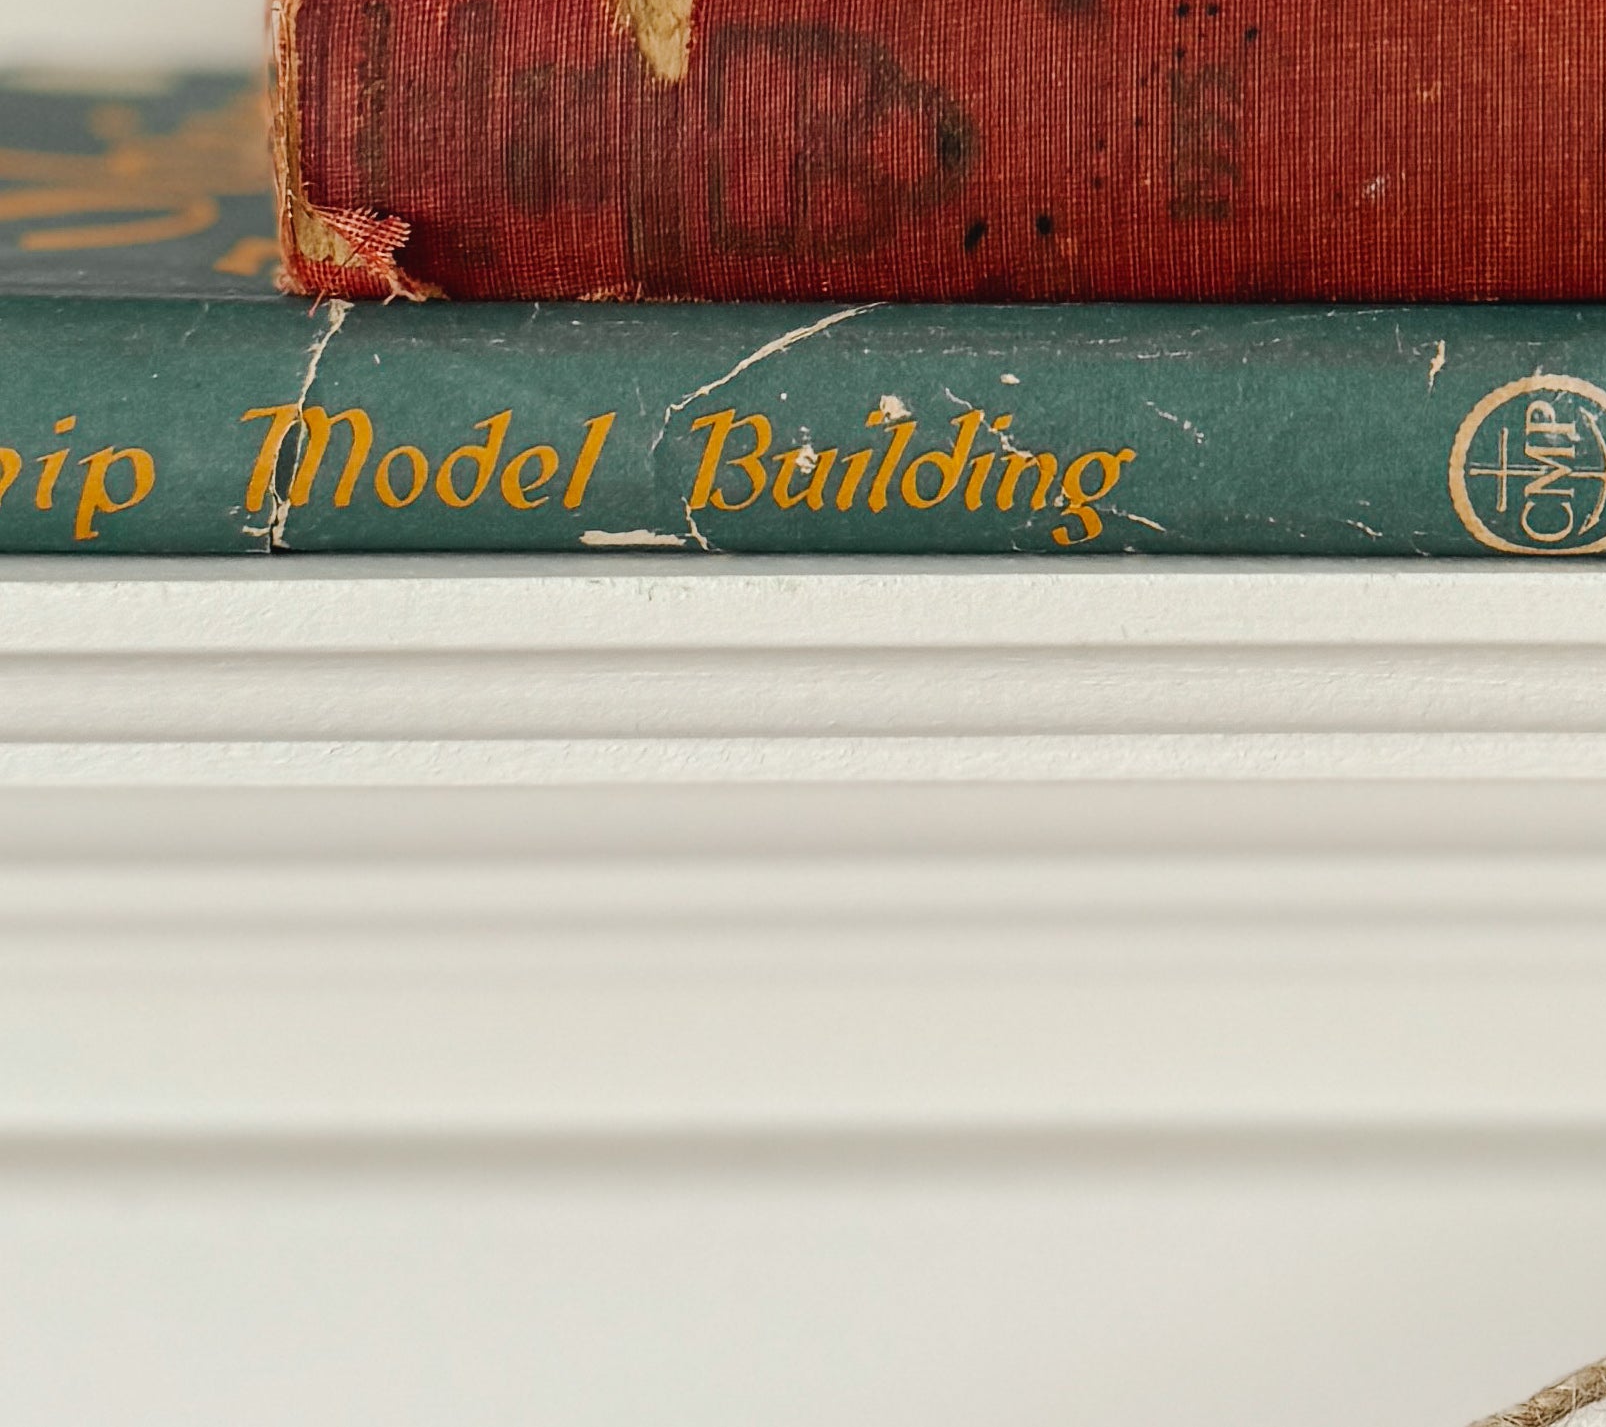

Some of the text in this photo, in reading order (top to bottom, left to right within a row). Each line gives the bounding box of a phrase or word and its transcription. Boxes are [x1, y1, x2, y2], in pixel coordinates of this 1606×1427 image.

[0, 405, 1137, 545] ip Model Building
[1520, 400, 1576, 543] CMP
